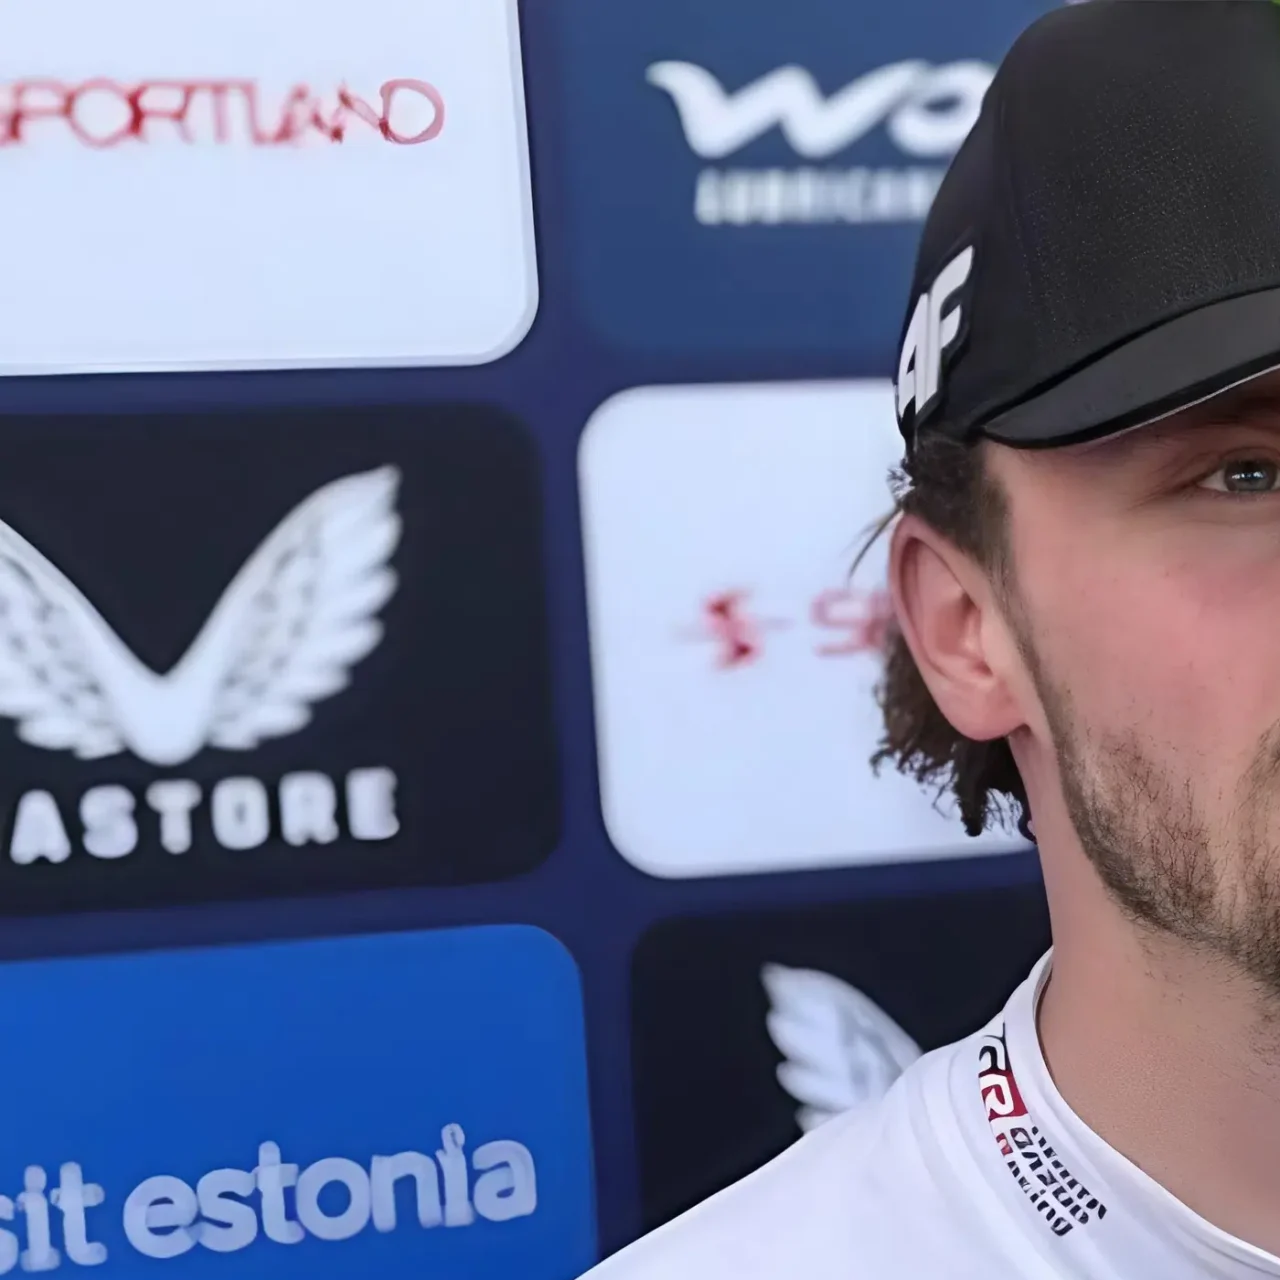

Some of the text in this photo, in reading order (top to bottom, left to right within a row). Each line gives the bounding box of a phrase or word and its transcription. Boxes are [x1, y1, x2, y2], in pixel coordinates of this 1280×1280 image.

[0, 78, 446, 148] PORTLAND
[645, 60, 997, 158] wo
[123, 1122, 538, 1259] estonia
